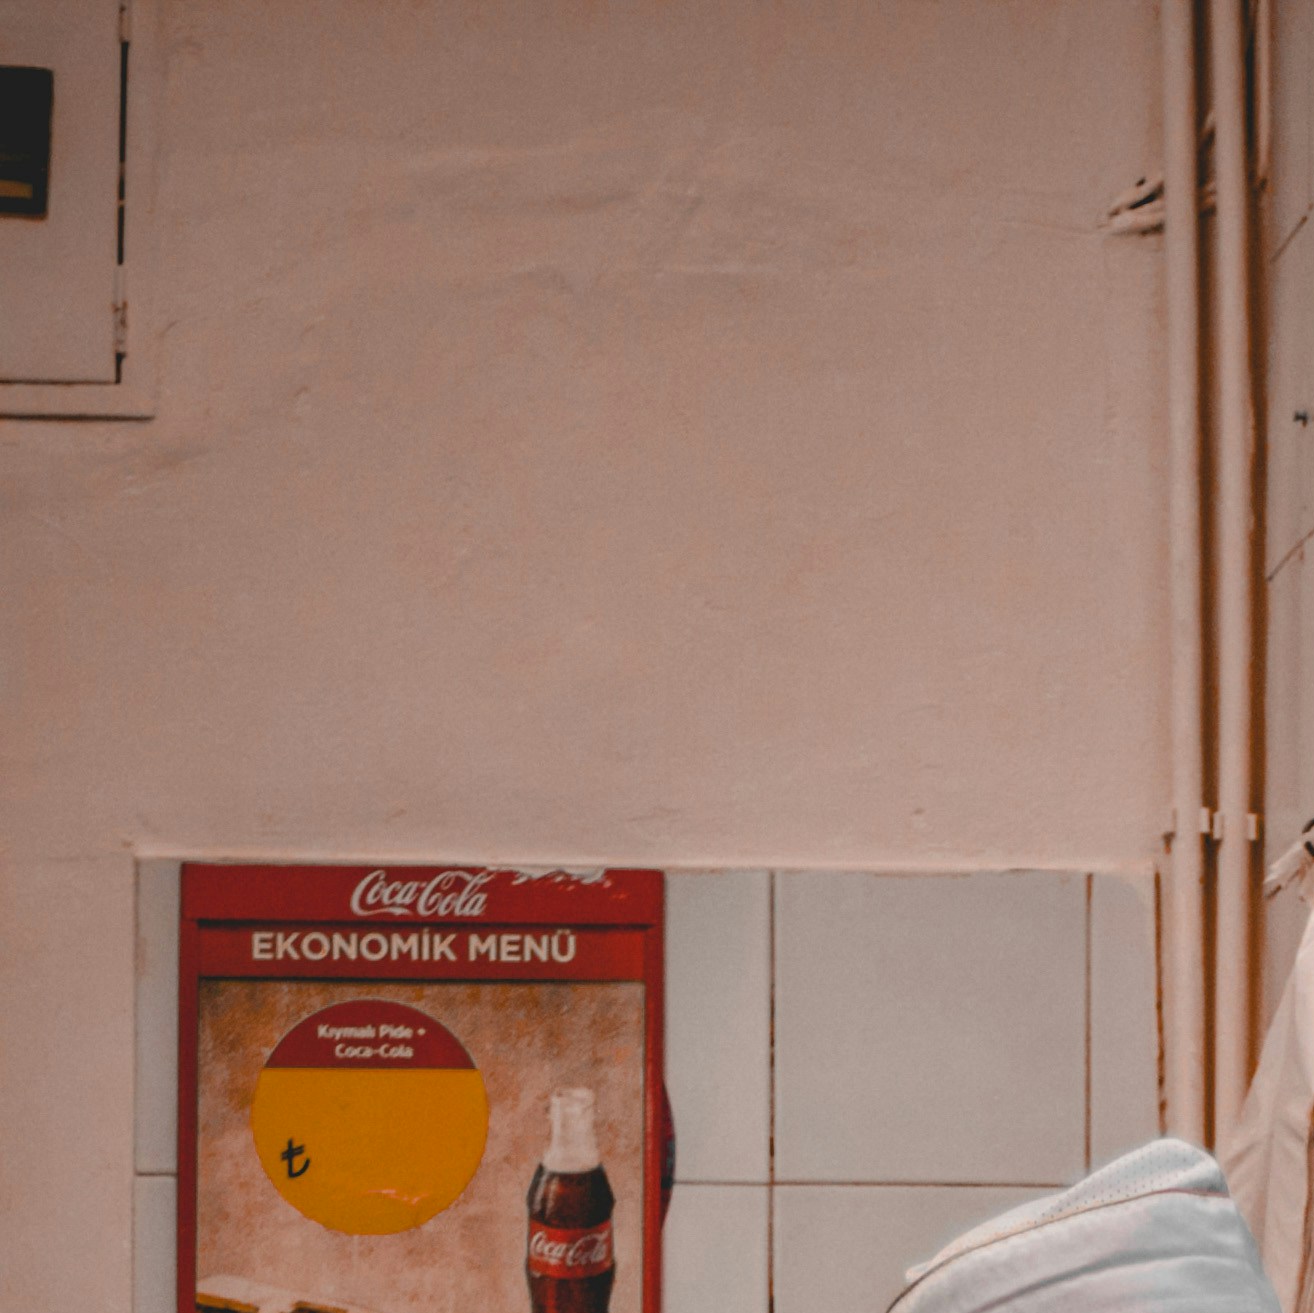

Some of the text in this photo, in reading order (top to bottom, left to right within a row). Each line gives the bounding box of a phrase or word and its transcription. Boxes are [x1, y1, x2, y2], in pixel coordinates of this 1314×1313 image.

[252, 928, 577, 963] EKONOMİK MENÜ
[379, 1024, 414, 1038] Pide
[335, 1043, 414, 1058] Coca-Cola
